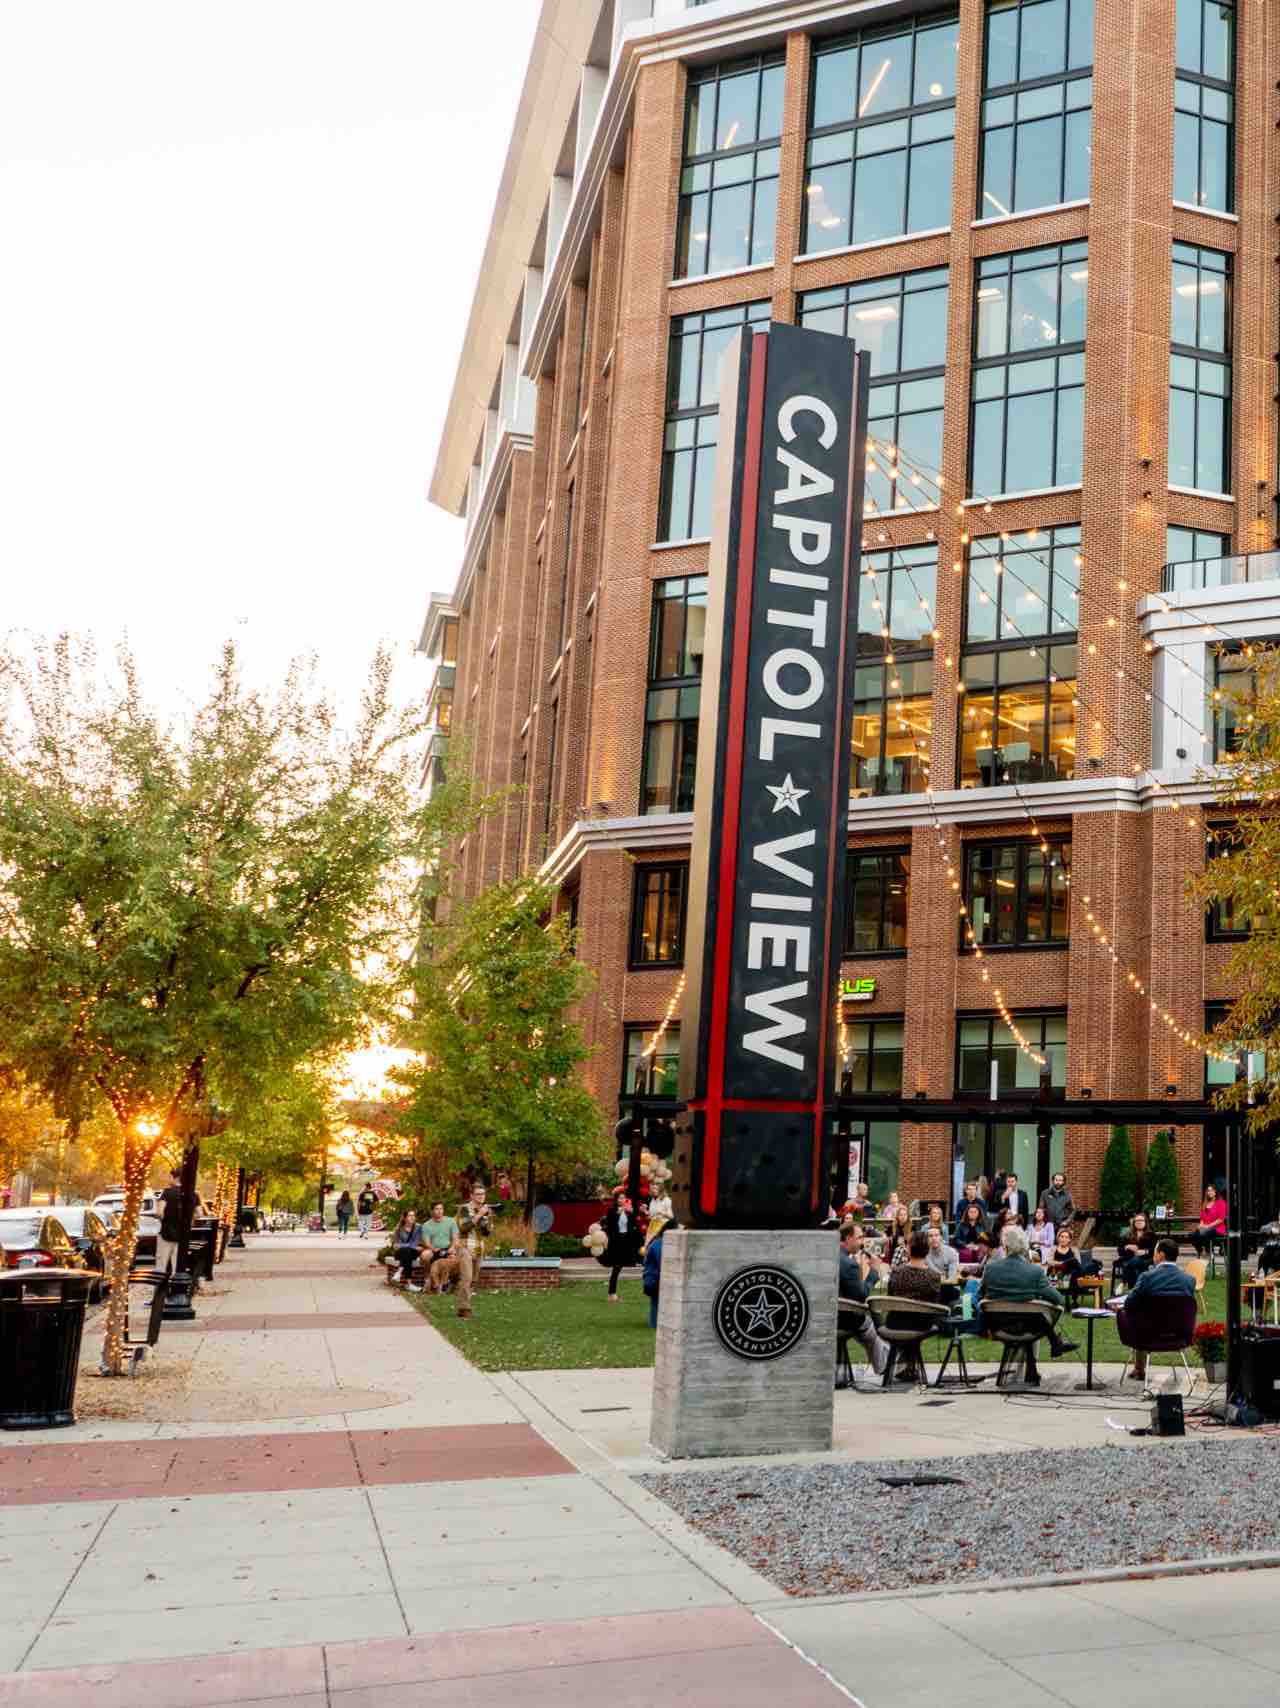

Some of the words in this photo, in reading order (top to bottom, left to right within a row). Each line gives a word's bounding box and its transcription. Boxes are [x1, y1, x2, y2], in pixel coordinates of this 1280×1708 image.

[759, 394, 838, 761] CAPITOL
[743, 829, 816, 1071] VIEW
[843, 978, 875, 992] US
[728, 1274, 773, 1303] CAPITOL
[776, 1278, 798, 1303] VIEW
[729, 1329, 793, 1352] NASHVILLE
